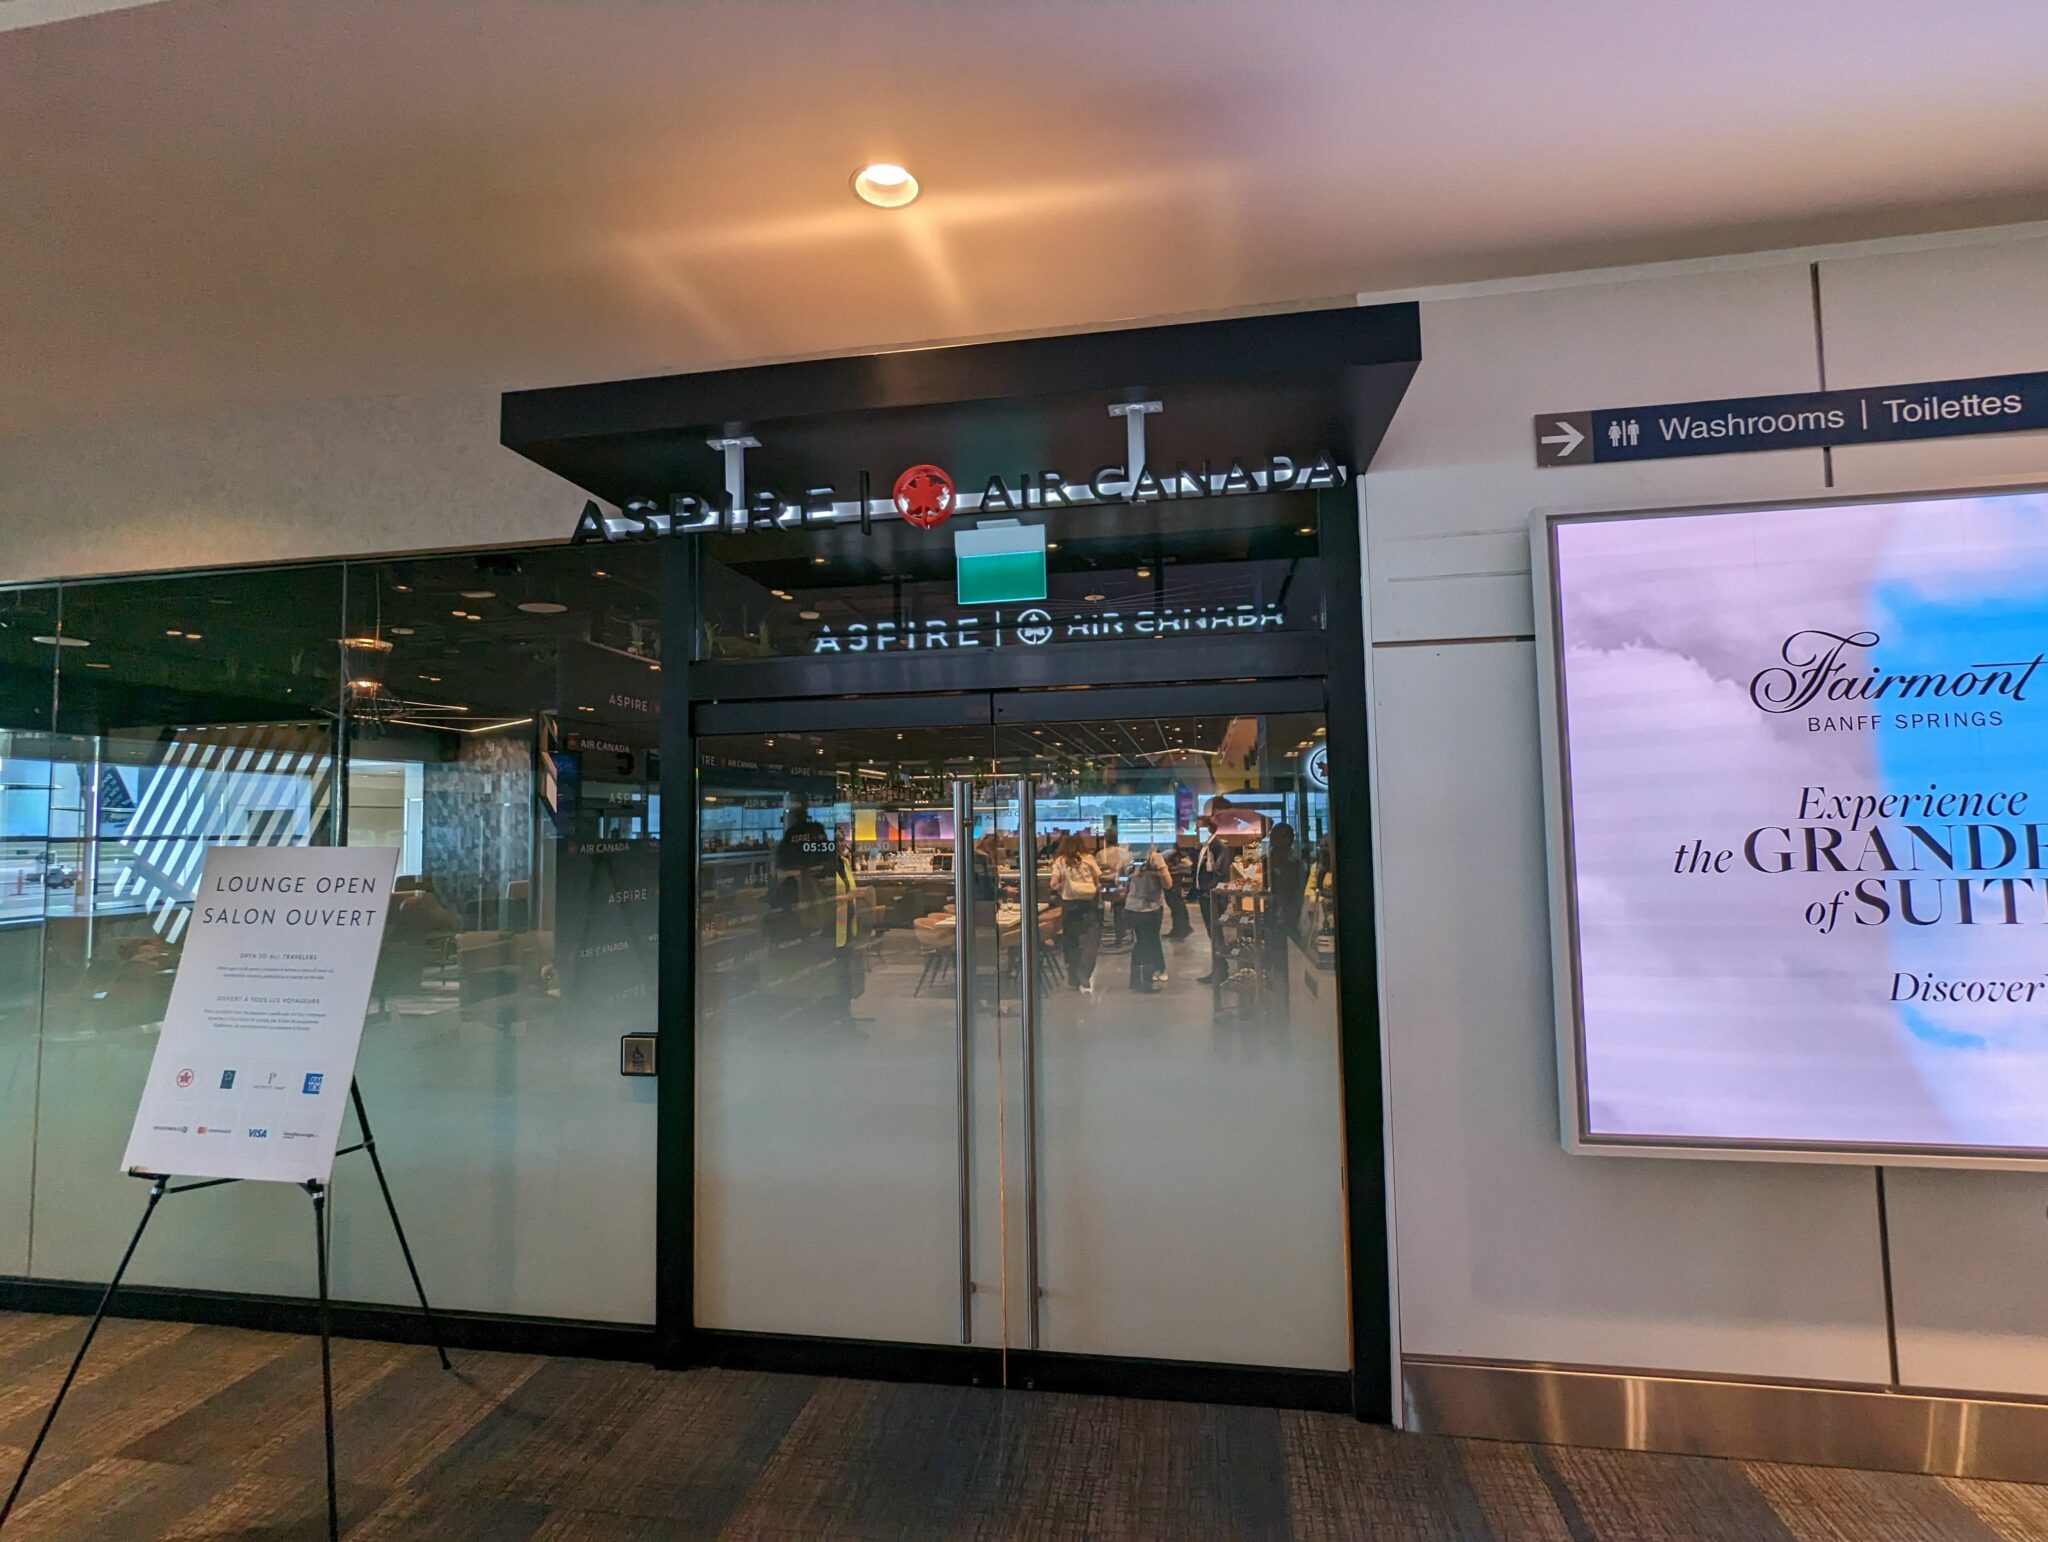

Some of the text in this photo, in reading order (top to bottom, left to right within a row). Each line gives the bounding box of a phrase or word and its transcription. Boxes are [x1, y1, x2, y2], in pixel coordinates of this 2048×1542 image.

[1658, 392, 2022, 441] Washrooms Toilettes
[573, 451, 1348, 545] ASPIRE AIR CANADA
[814, 618, 980, 654] ASPIRE
[1067, 613, 1123, 635] AIR
[1750, 630, 2048, 714] Fairmont
[609, 694, 648, 712] ASPIRE
[1808, 711, 2004, 732] BANFF SPRINGS
[580, 739, 630, 753] AIR CANADA
[608, 792, 647, 805] ASPE
[1797, 783, 2029, 831] Experience
[580, 842, 630, 855] AIR CANADA
[803, 842, 836, 852] 05:30
[1673, 839, 1733, 874] the
[216, 875, 377, 894] LOUNGE OPEN
[608, 888, 648, 905] ASPIRE
[1804, 878, 2048, 935] of SUIT
[203, 907, 377, 926] SALON OUVERT
[240, 952, 257, 960] OPEN
[1890, 971, 2044, 1004] Discover
[248, 1129, 268, 1138] VISA
